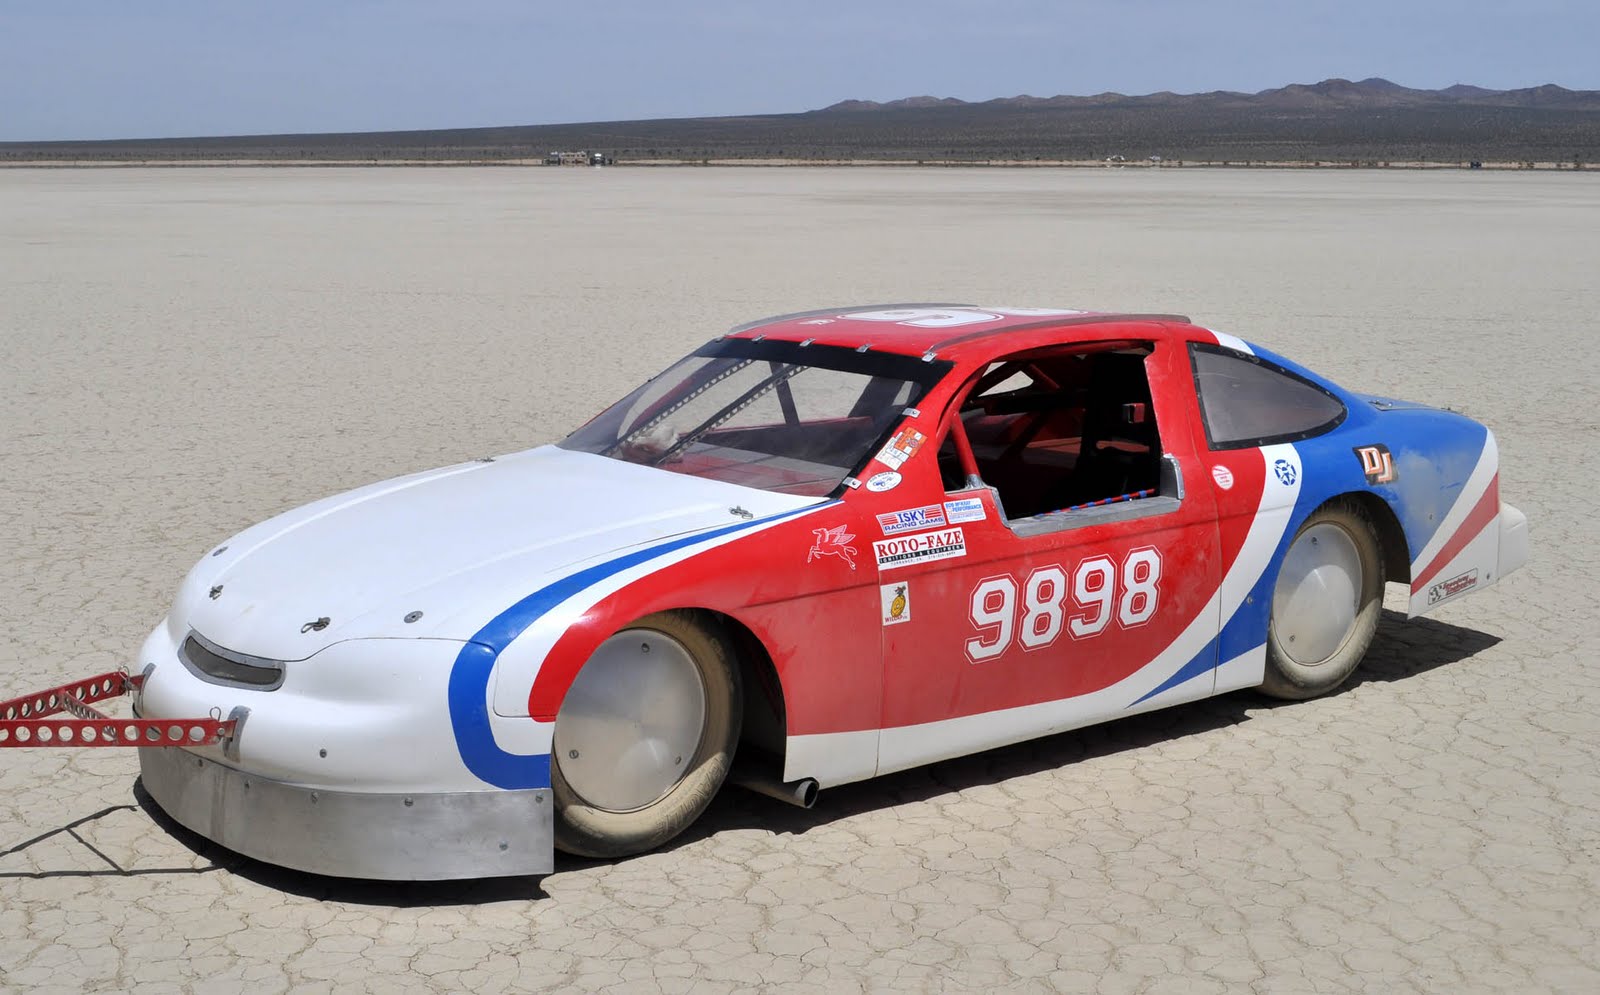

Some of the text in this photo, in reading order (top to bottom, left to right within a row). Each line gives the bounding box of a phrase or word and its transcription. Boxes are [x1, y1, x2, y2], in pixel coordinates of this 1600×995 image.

[1357, 447, 1393, 482] DJ
[884, 520, 917, 531] RACING
[918, 517, 944, 525] CAMS
[896, 509, 926, 523] ISKY
[876, 530, 963, 557] ROTO-FAZE
[879, 552, 916, 564] IGNITIONS
[927, 545, 964, 555] EQUIPMENT
[964, 545, 1163, 664] 9898
